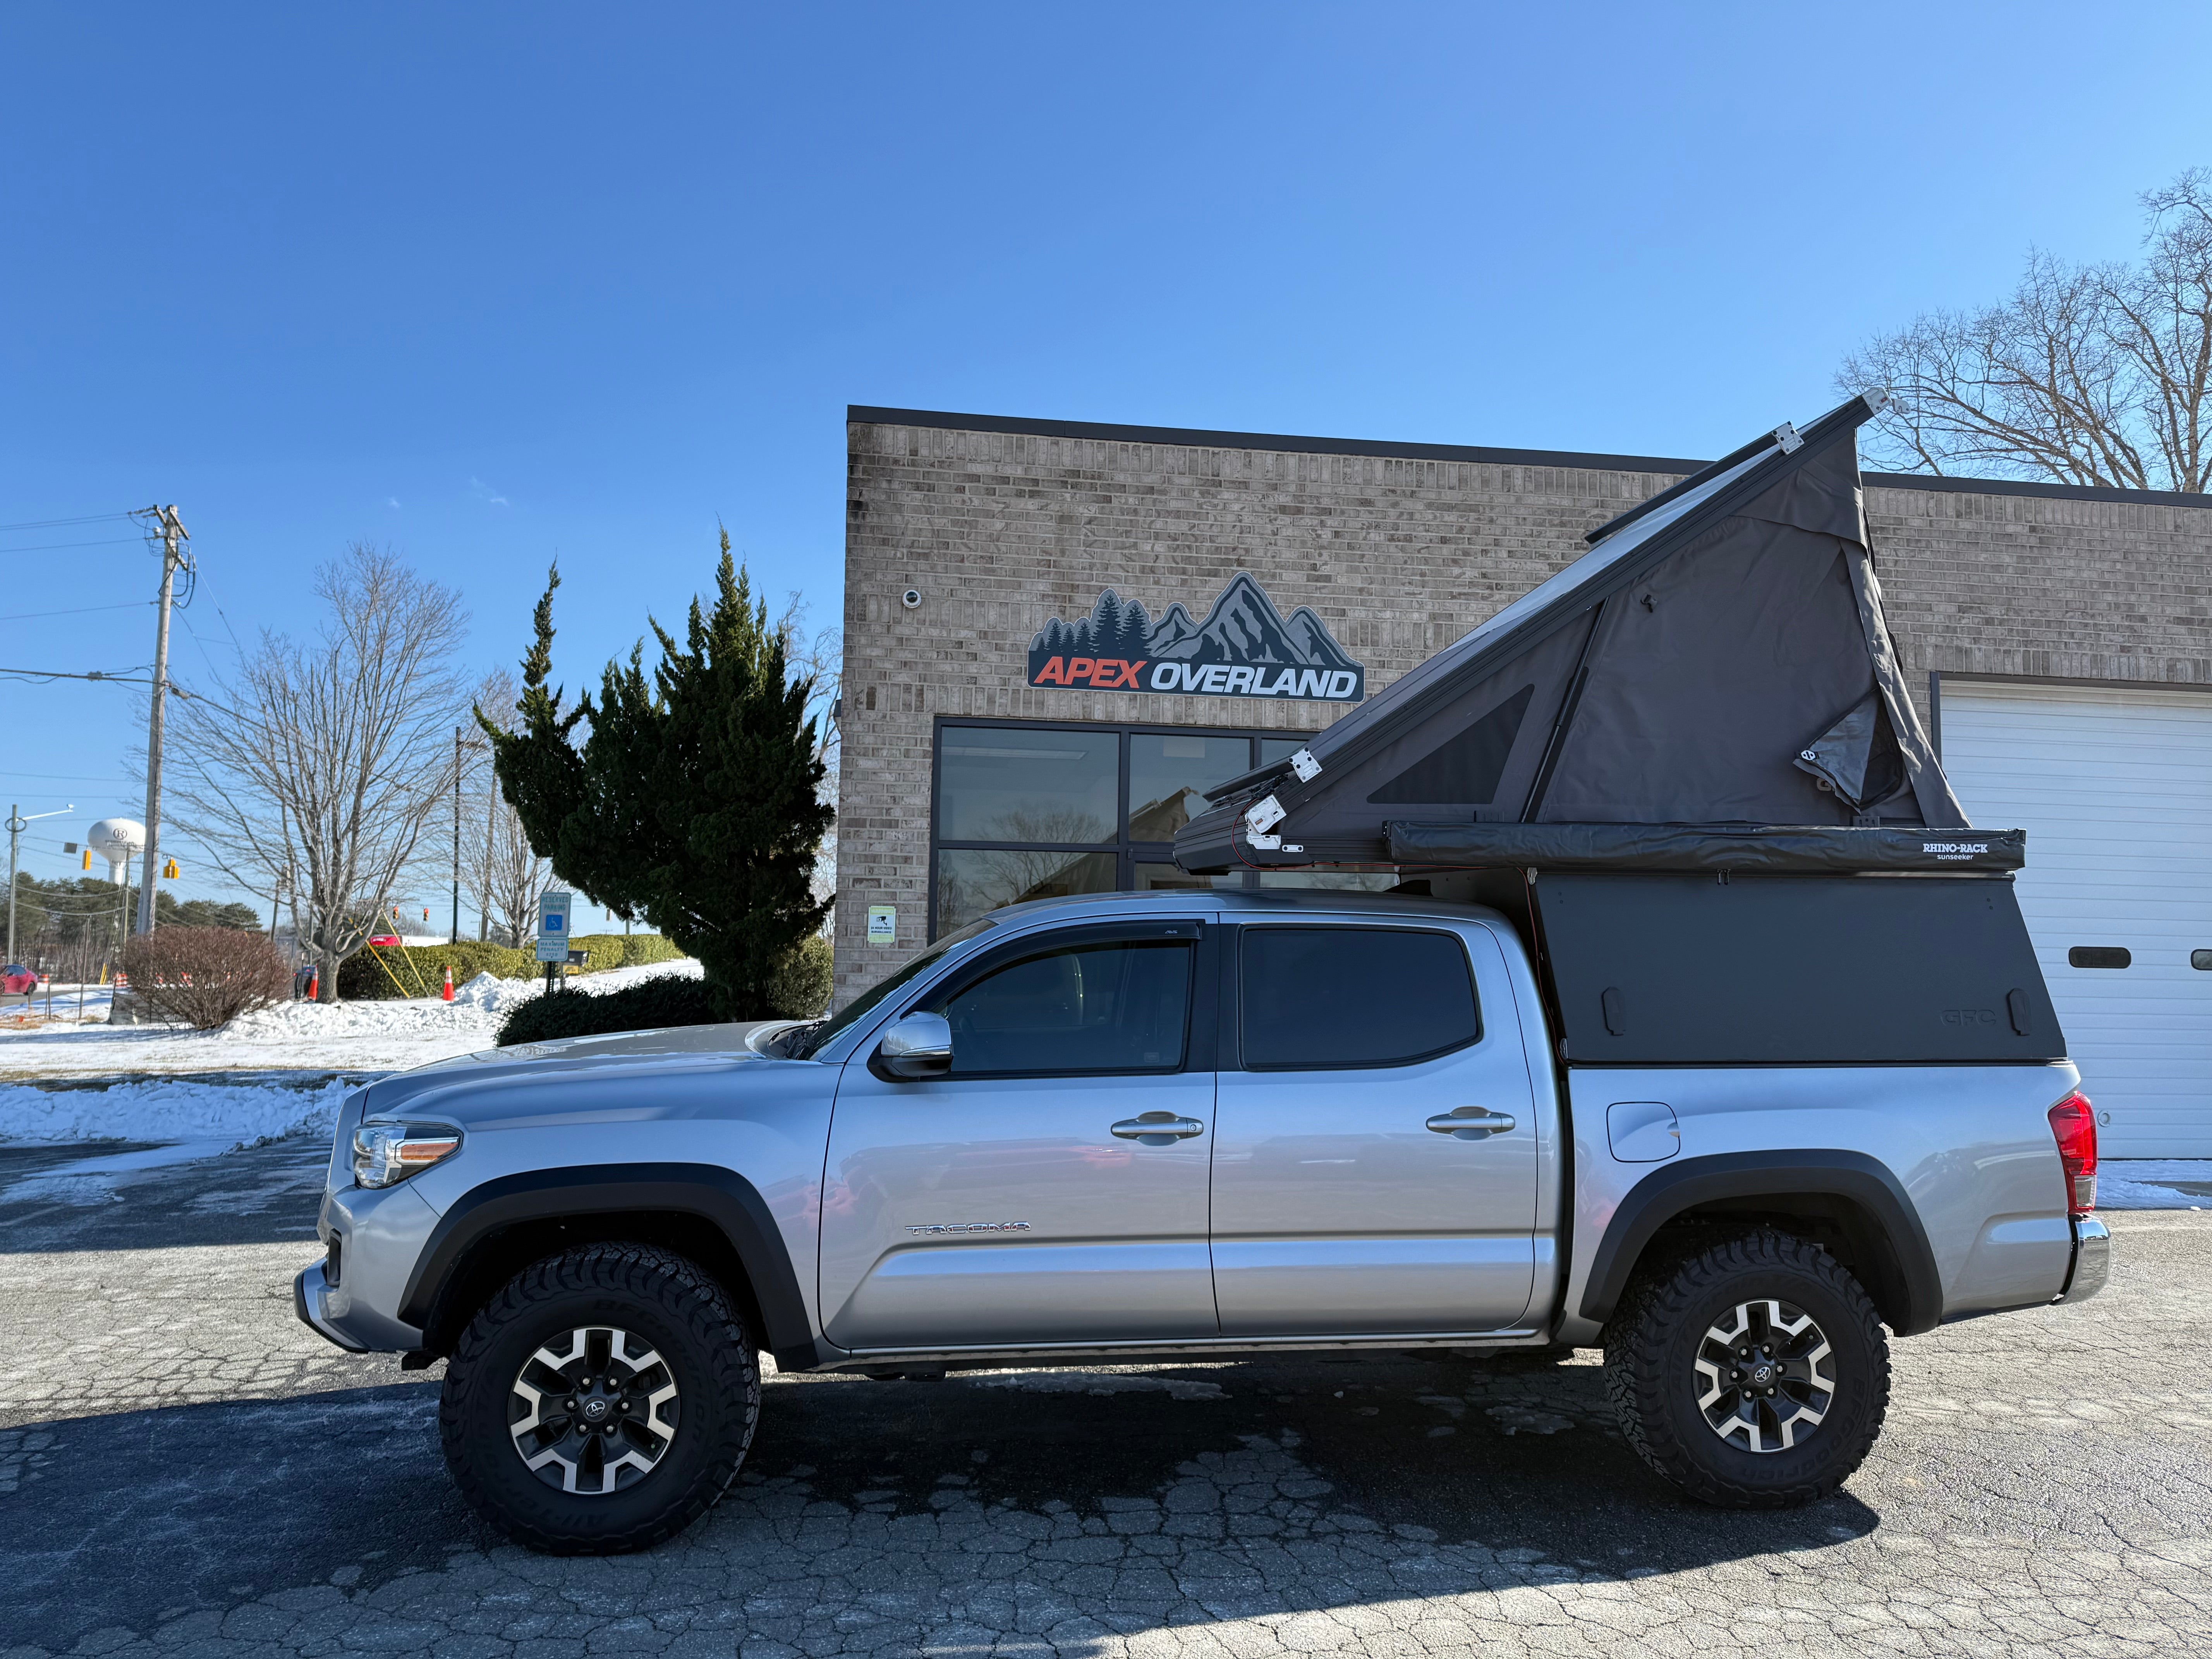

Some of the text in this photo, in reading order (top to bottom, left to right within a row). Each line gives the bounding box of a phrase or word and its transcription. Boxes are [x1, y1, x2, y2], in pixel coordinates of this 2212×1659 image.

[1034, 656, 1357, 698] APEX OVERLAND
[1923, 843, 1988, 853] RHINO-RACK
[1940, 1009, 1996, 1025] GFC
[905, 1222, 1031, 1235] TACOMA
